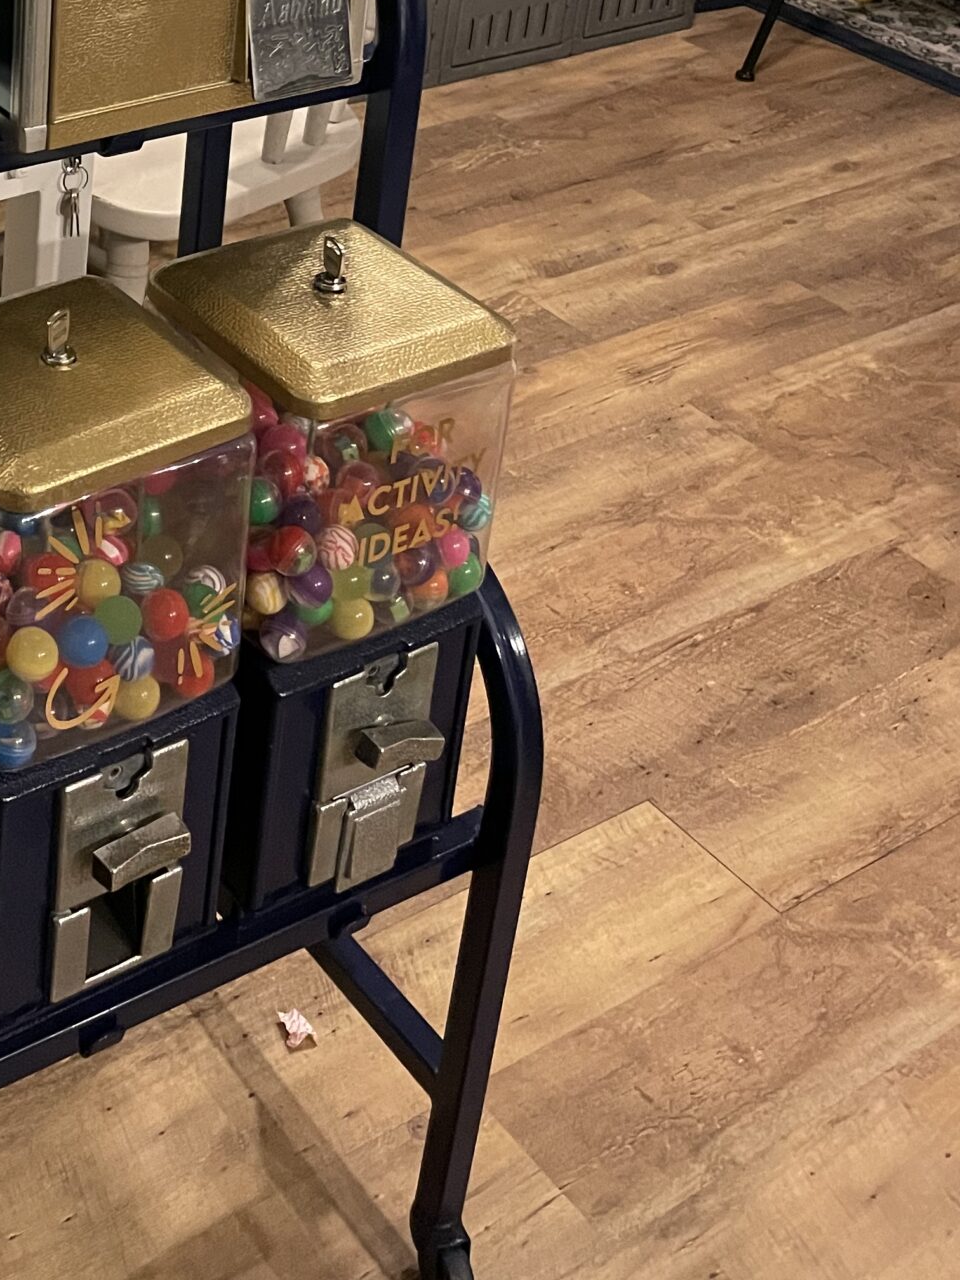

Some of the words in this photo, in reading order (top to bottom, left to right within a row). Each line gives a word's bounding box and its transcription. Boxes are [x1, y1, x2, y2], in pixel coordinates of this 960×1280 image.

[390, 417, 456, 465] FOR
[341, 447, 488, 526] ACTIVITY
[358, 503, 460, 568] IDEAS!
